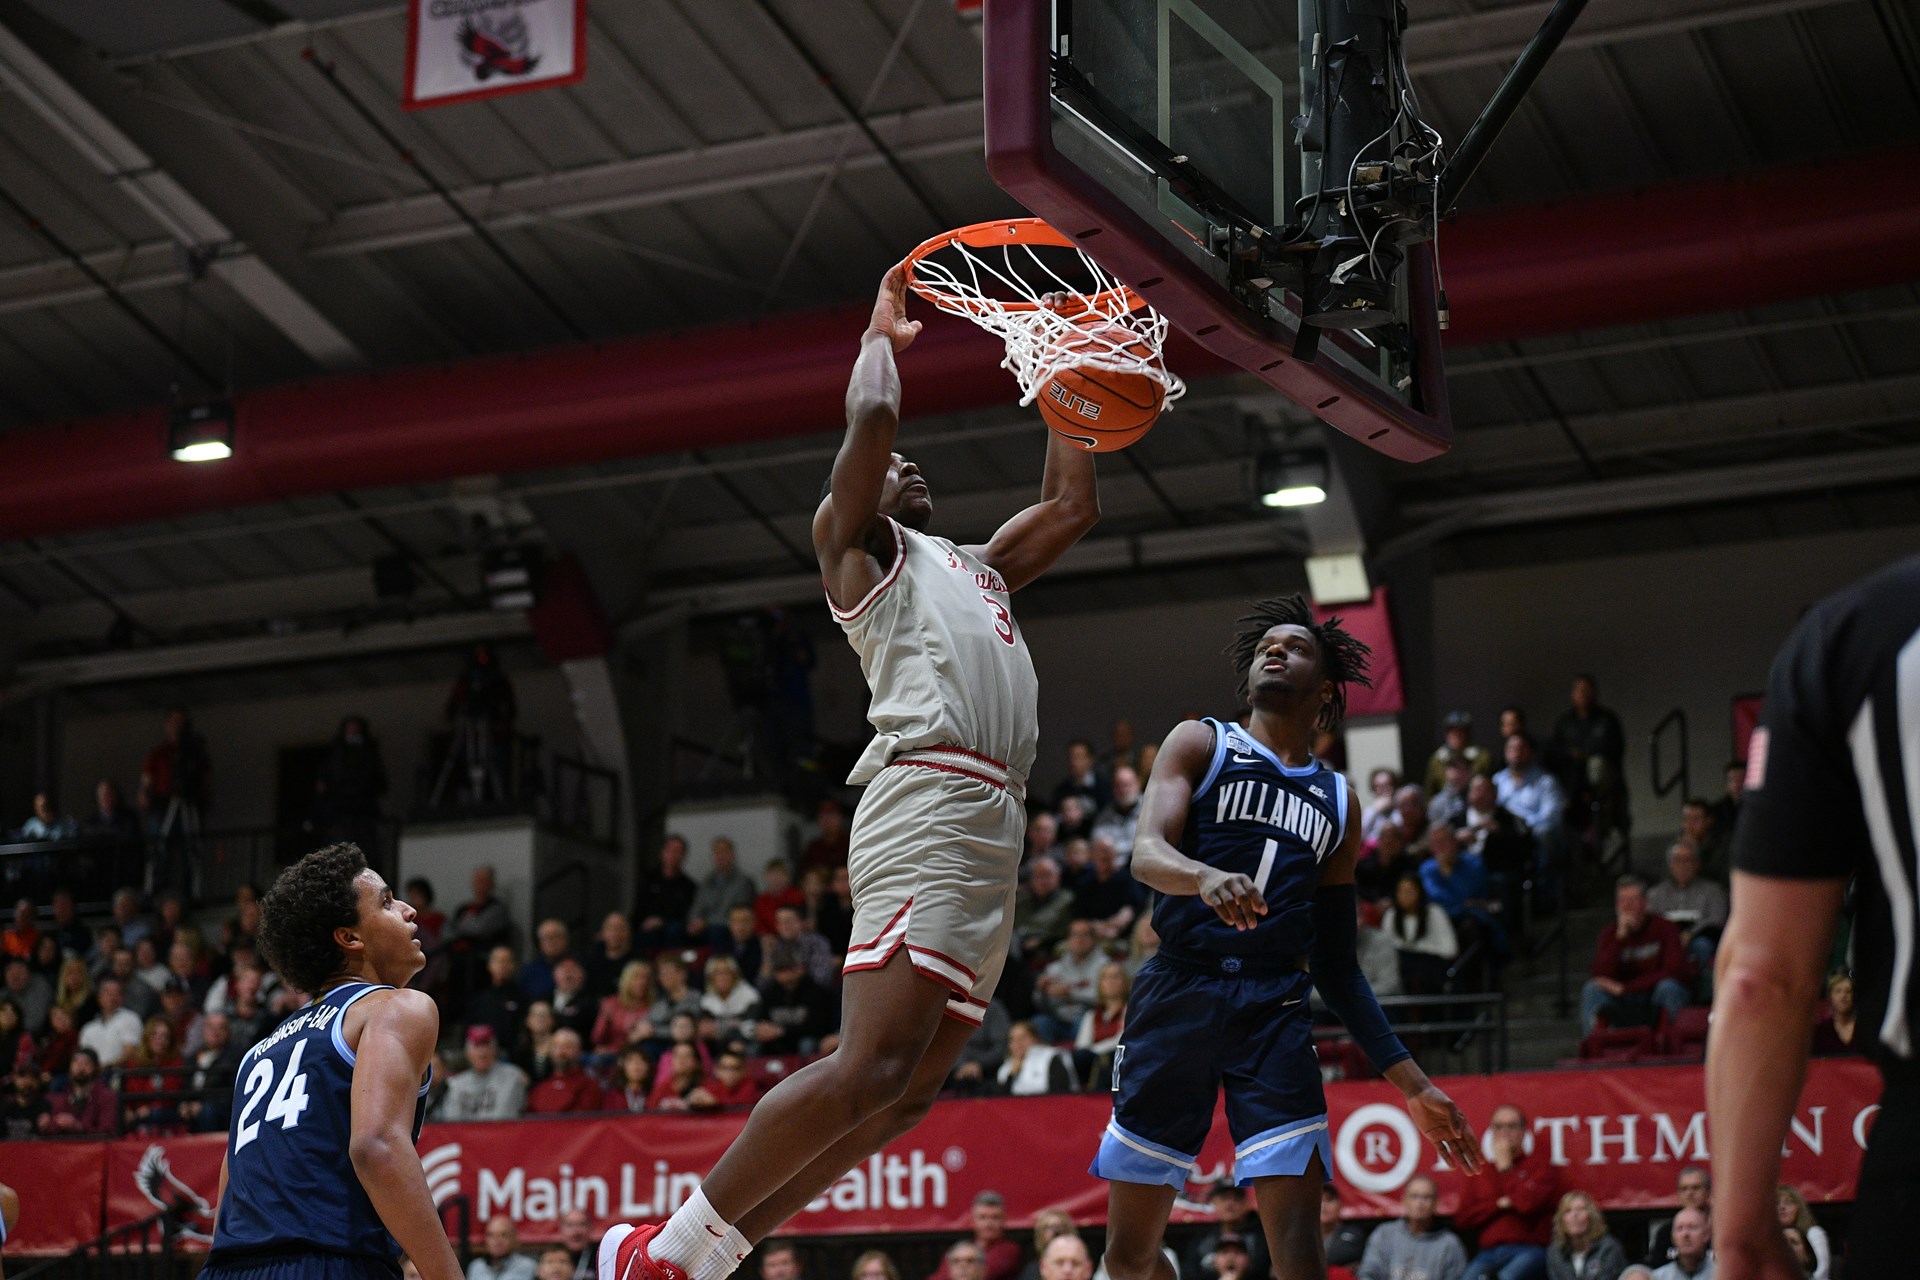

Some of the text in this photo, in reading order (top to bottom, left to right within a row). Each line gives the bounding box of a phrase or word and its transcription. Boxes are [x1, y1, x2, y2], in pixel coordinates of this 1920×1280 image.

[1048, 381, 1102, 420] ELITE
[981, 593, 1015, 647] 3
[1254, 838, 1278, 898] 1
[235, 1038, 309, 1155] 24
[1364, 1128, 1395, 1164] R
[477, 1164, 609, 1222] Main
[620, 1160, 703, 1218] Lin
